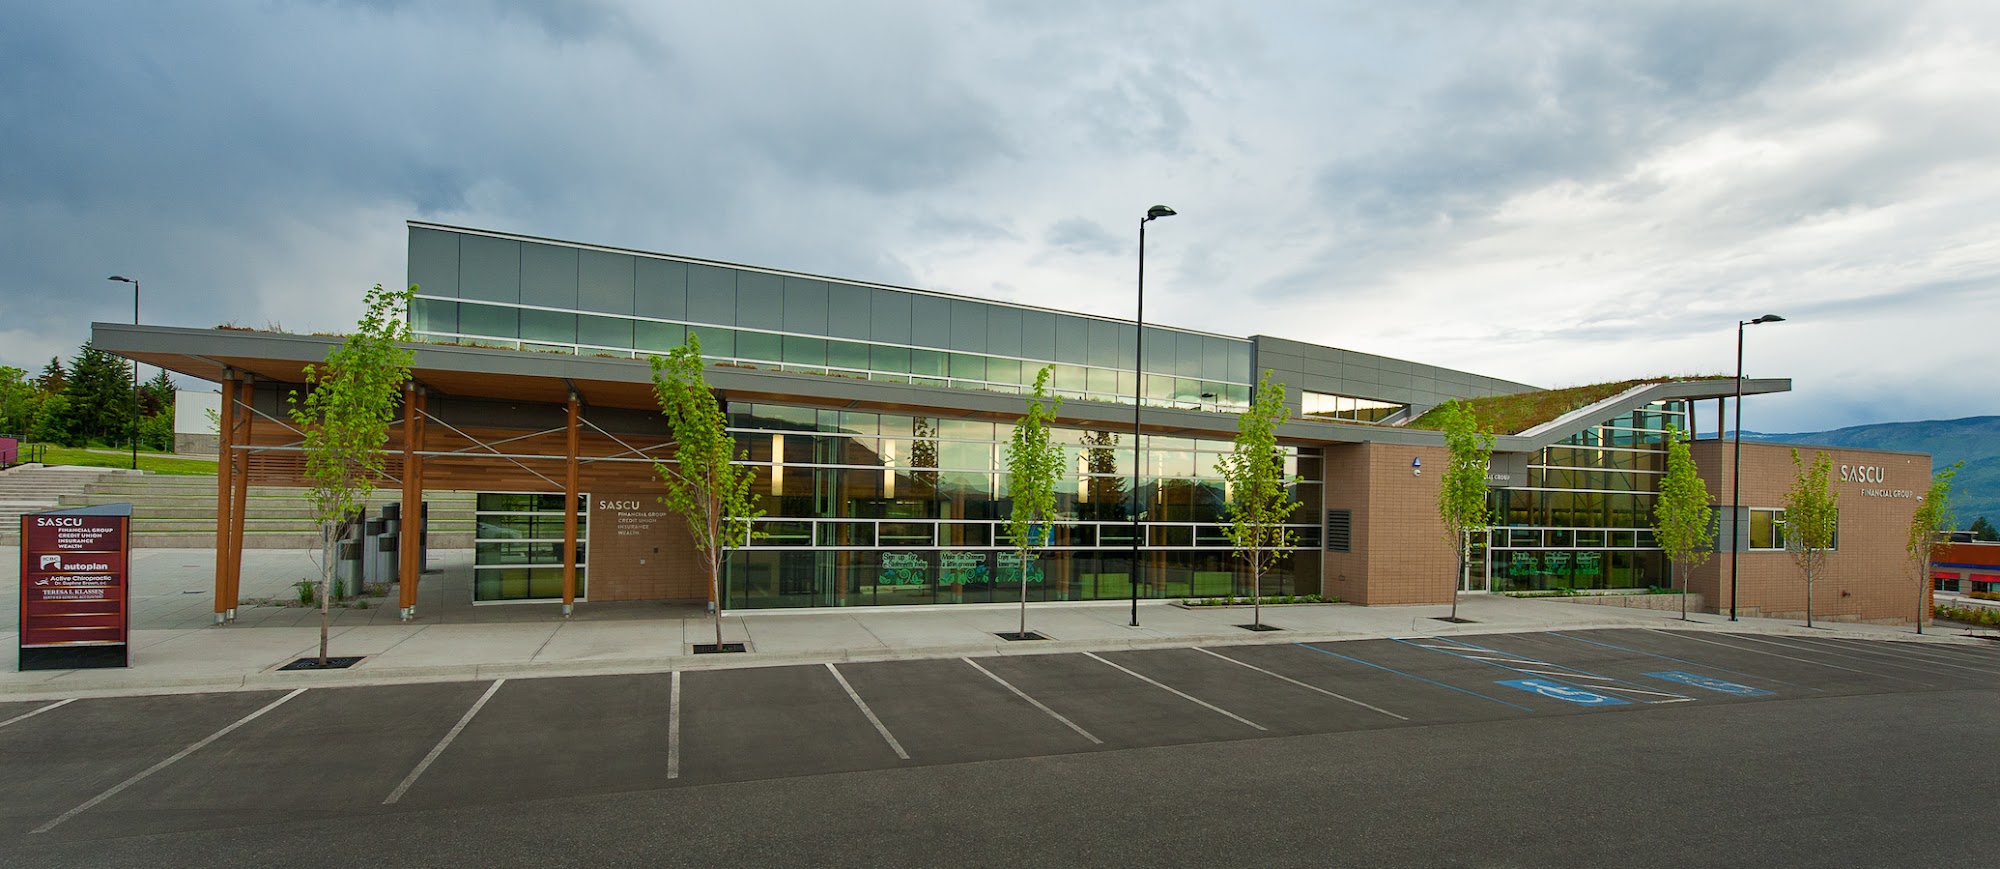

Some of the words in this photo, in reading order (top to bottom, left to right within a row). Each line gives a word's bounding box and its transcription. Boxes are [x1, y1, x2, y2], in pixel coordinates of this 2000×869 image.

[1840, 464, 1885, 483] SASCU
[1860, 488, 1892, 498] FINANCIAL
[1893, 490, 1914, 499] GROUP
[599, 500, 640, 510] SASCU
[37, 517, 83, 527] SASCU
[64, 562, 108, 571] autoplan
